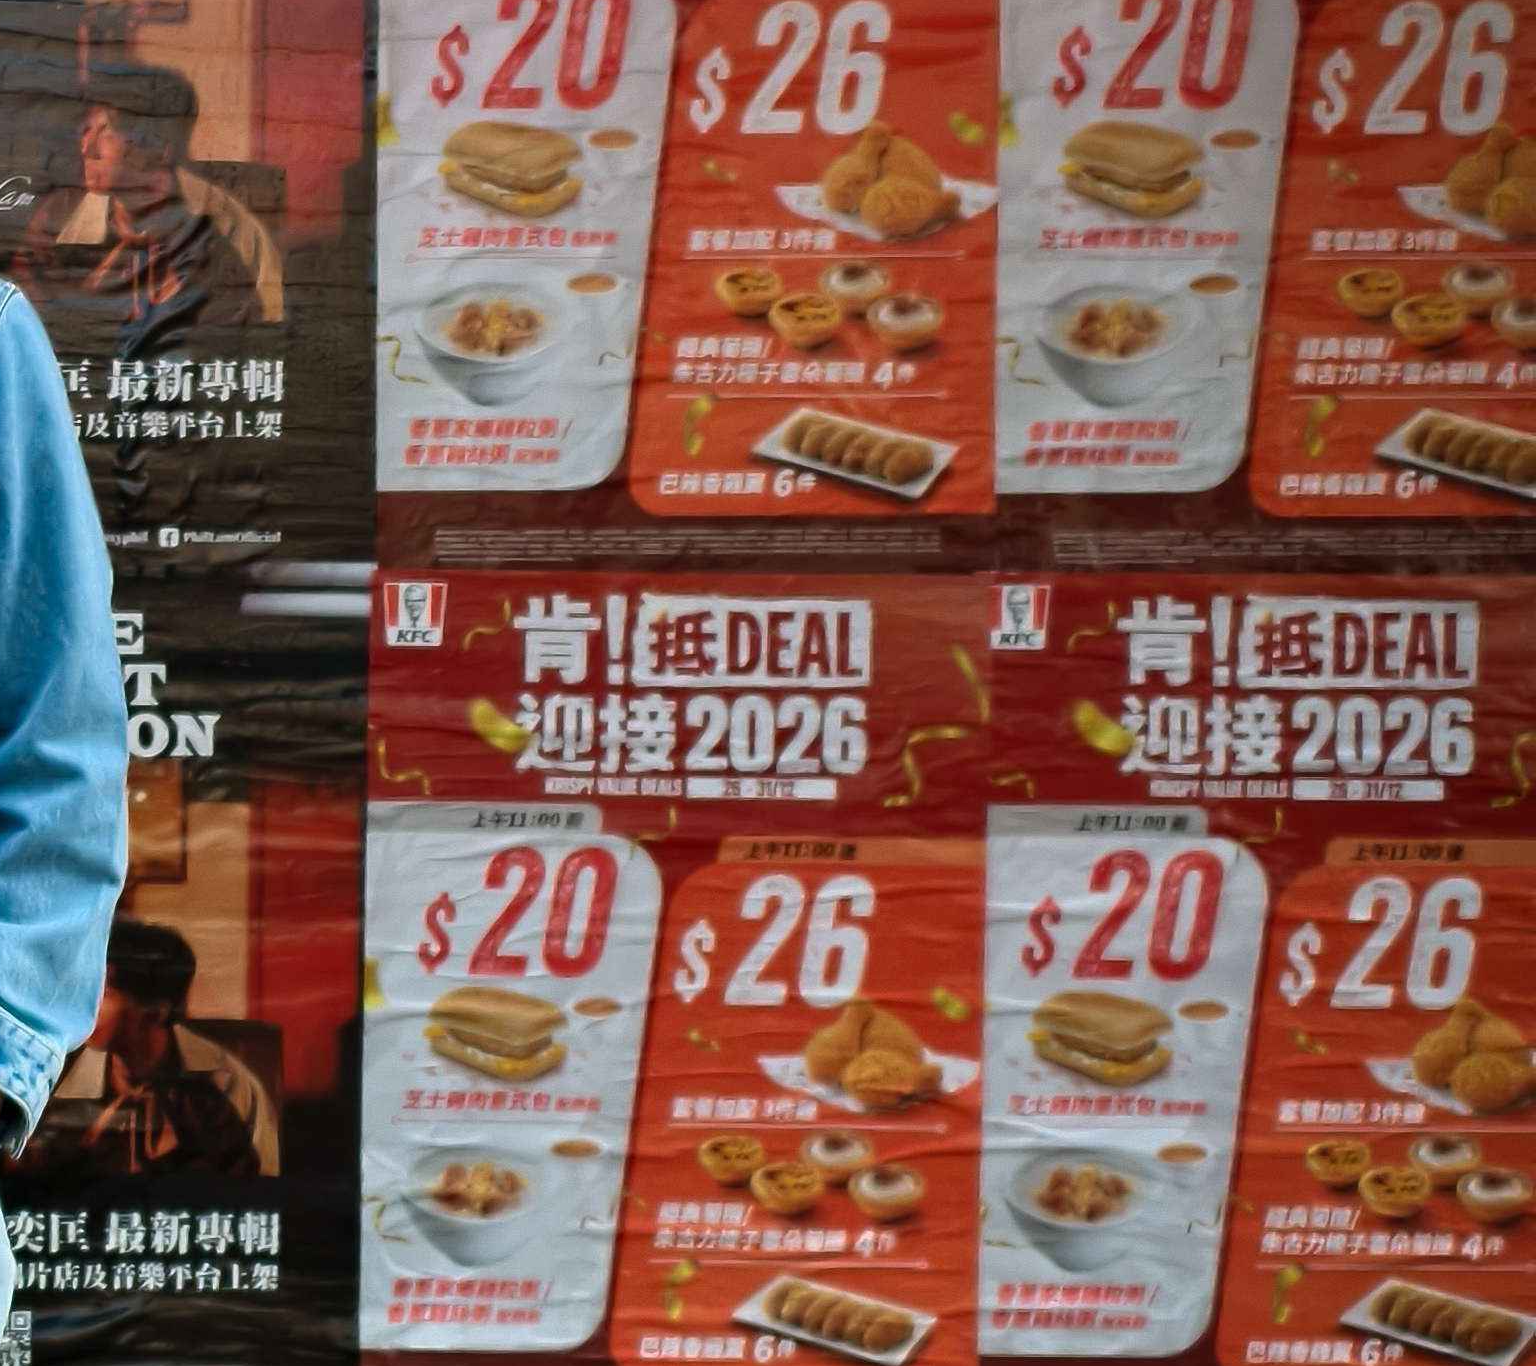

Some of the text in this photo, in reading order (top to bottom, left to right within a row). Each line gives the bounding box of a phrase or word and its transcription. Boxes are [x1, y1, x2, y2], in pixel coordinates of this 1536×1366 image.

[689, 0, 892, 135] $26
[107, 358, 285, 403] 最新專輯
[395, 628, 433, 644] KFC
[999, 633, 1039, 646] KFC
[417, 845, 618, 979] $20
[674, 874, 875, 1008] $26
[1020, 848, 1225, 983] $20
[1279, 877, 1482, 1011] $26
[6, 1211, 280, 1255] 奕匡 最新專輯
